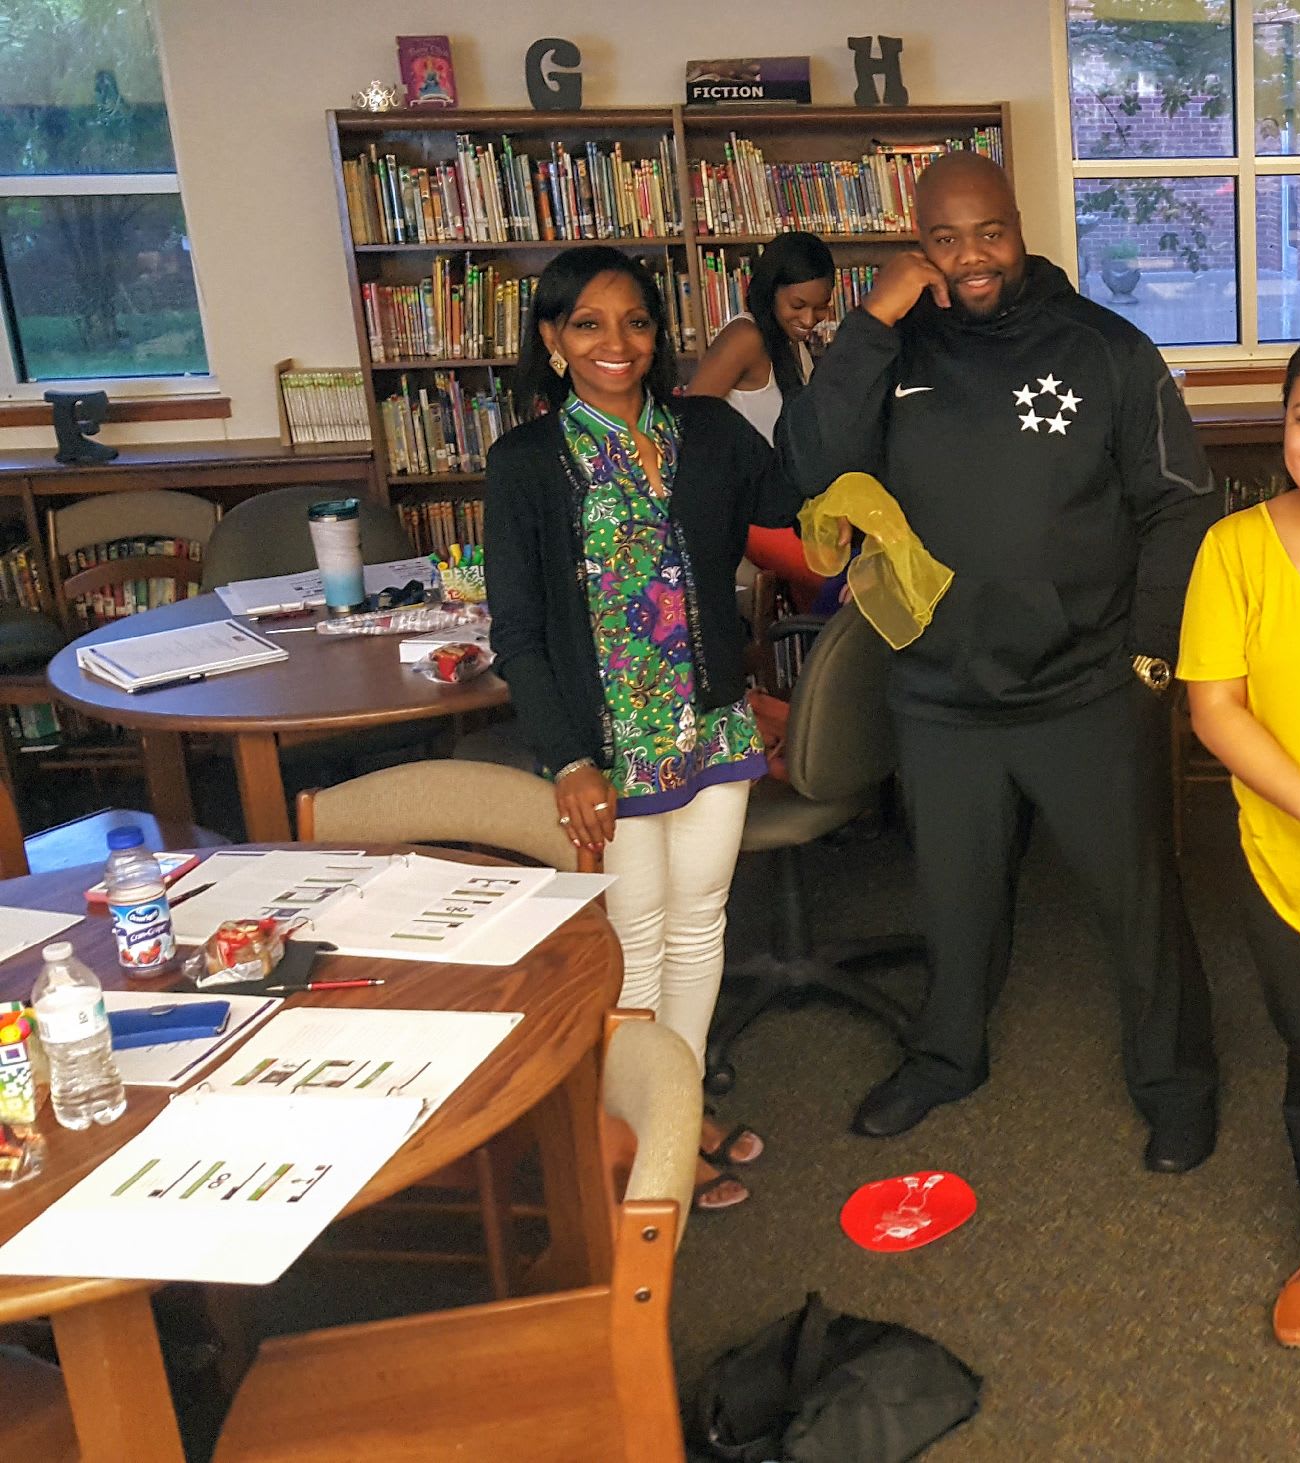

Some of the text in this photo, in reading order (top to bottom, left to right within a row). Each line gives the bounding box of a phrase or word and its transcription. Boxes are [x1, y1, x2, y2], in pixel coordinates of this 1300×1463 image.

[525, 38, 582, 112] G
[692, 86, 765, 99] FICTION
[847, 36, 909, 105] H
[44, 389, 119, 464] R
